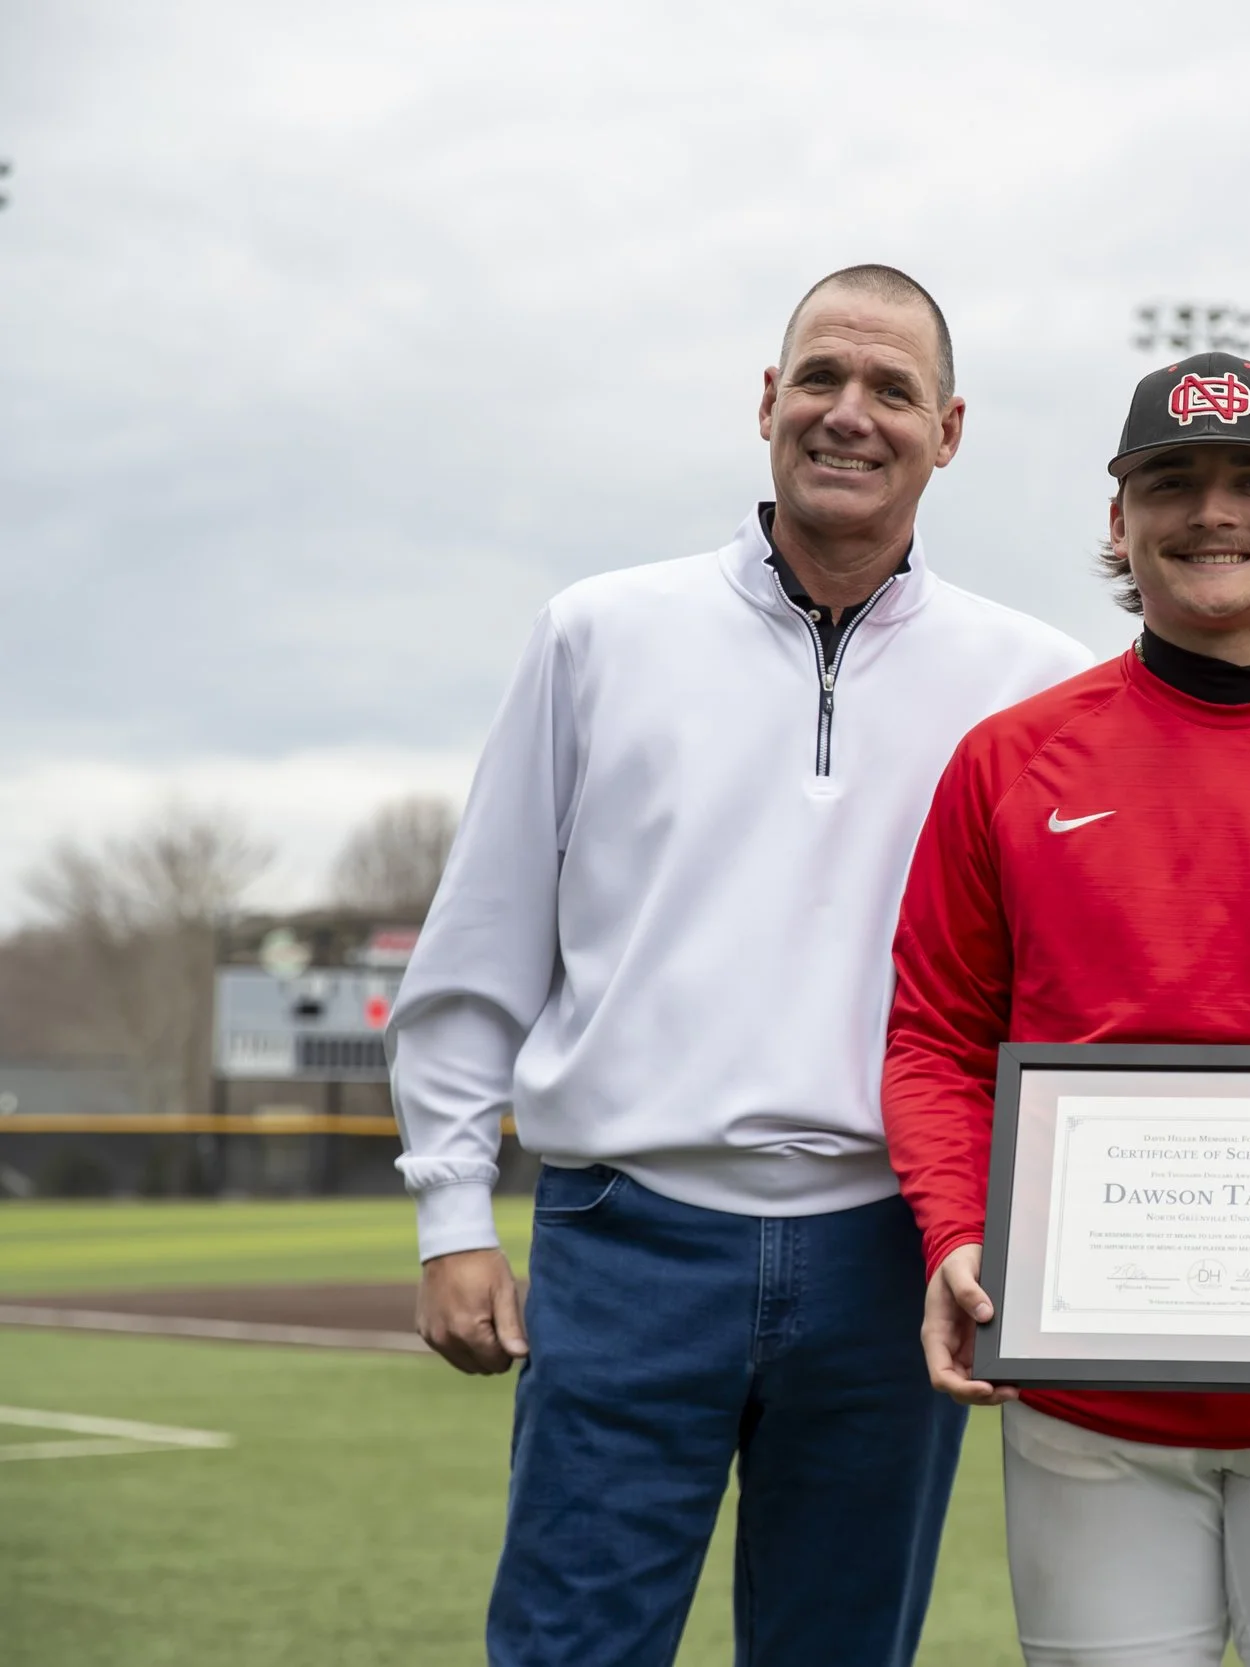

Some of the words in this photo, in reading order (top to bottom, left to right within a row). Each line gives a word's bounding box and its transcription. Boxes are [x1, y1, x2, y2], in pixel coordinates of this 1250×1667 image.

[1107, 1145, 1199, 1160] CERTIFICATE
[1203, 1149, 1221, 1161] OF
[1103, 1183, 1214, 1206] DAWSON
